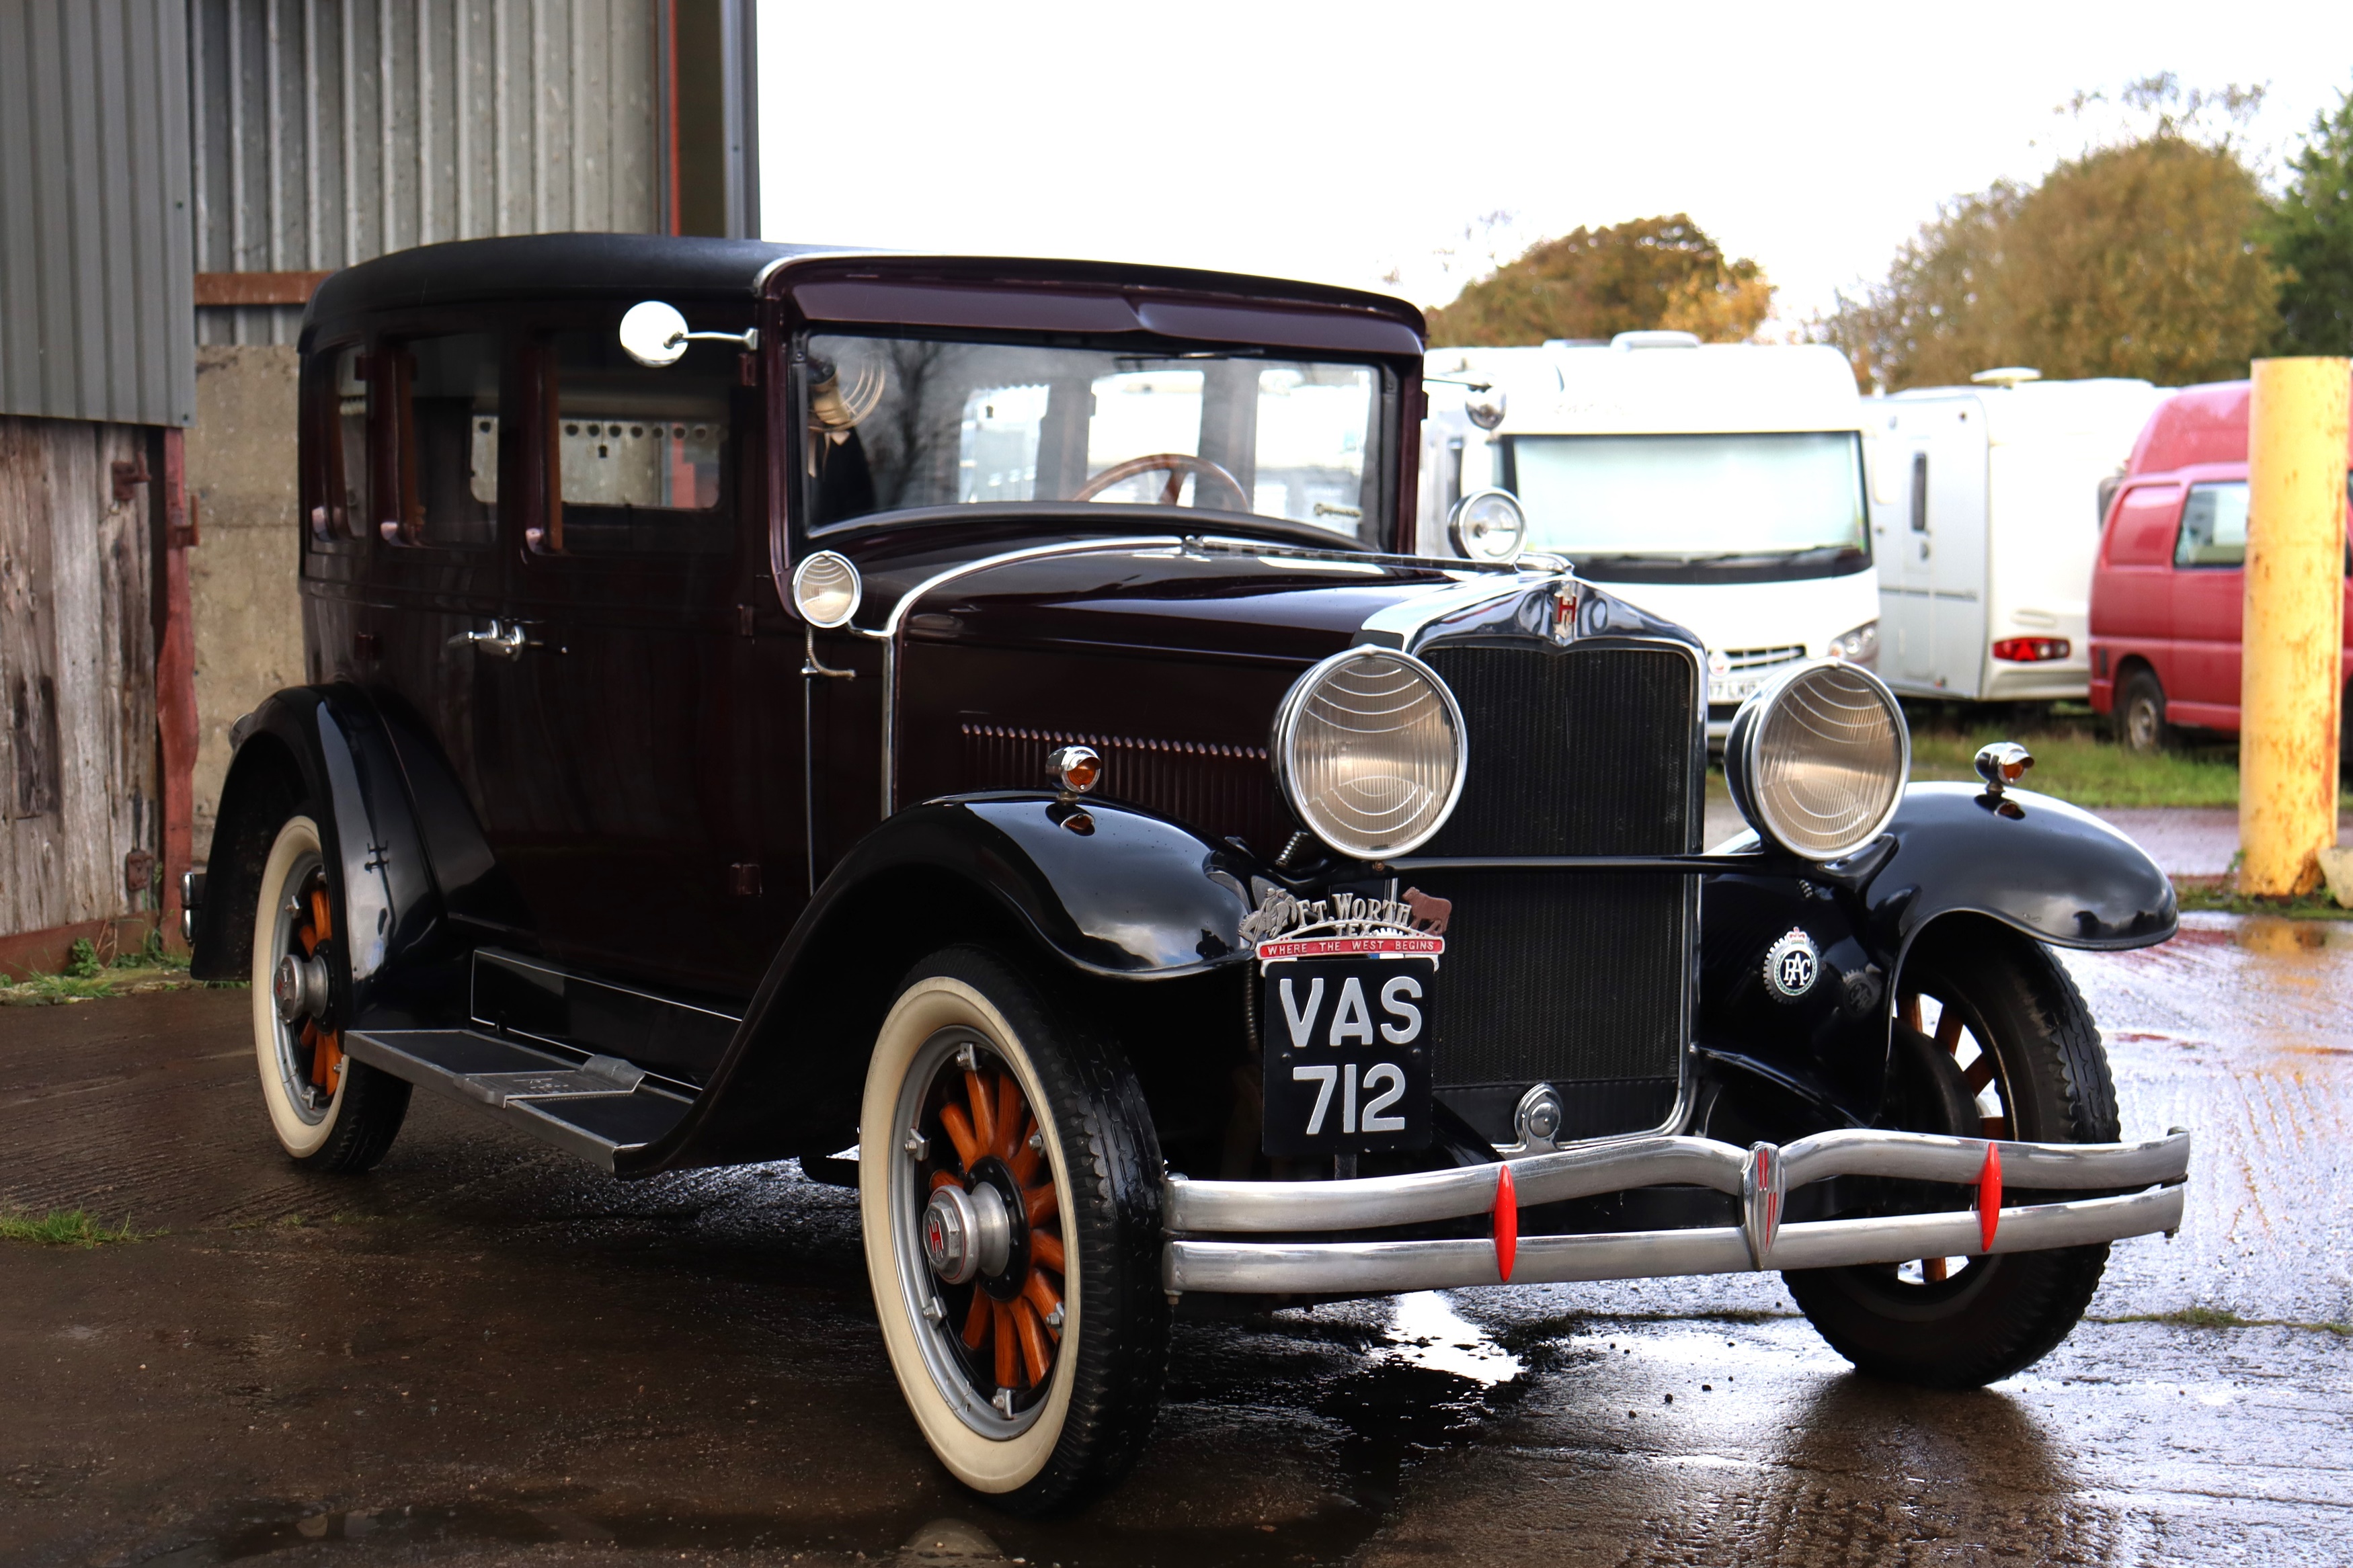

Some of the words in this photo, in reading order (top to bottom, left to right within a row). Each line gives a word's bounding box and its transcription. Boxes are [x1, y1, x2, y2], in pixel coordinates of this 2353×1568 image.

[1558, 595, 1577, 624] H
[1295, 899, 1334, 929] FT.
[1331, 892, 1412, 927] WORTH
[1334, 923, 1377, 937] TEX.
[1267, 943, 1308, 956] WHERE
[1319, 942, 1341, 952] THE
[1352, 940, 1385, 950] WEST
[1395, 940, 1435, 951] BEGINS
[1783, 952, 1811, 987] RAC
[1279, 976, 1423, 1048] VAS
[1292, 1063, 1406, 1135] 712
